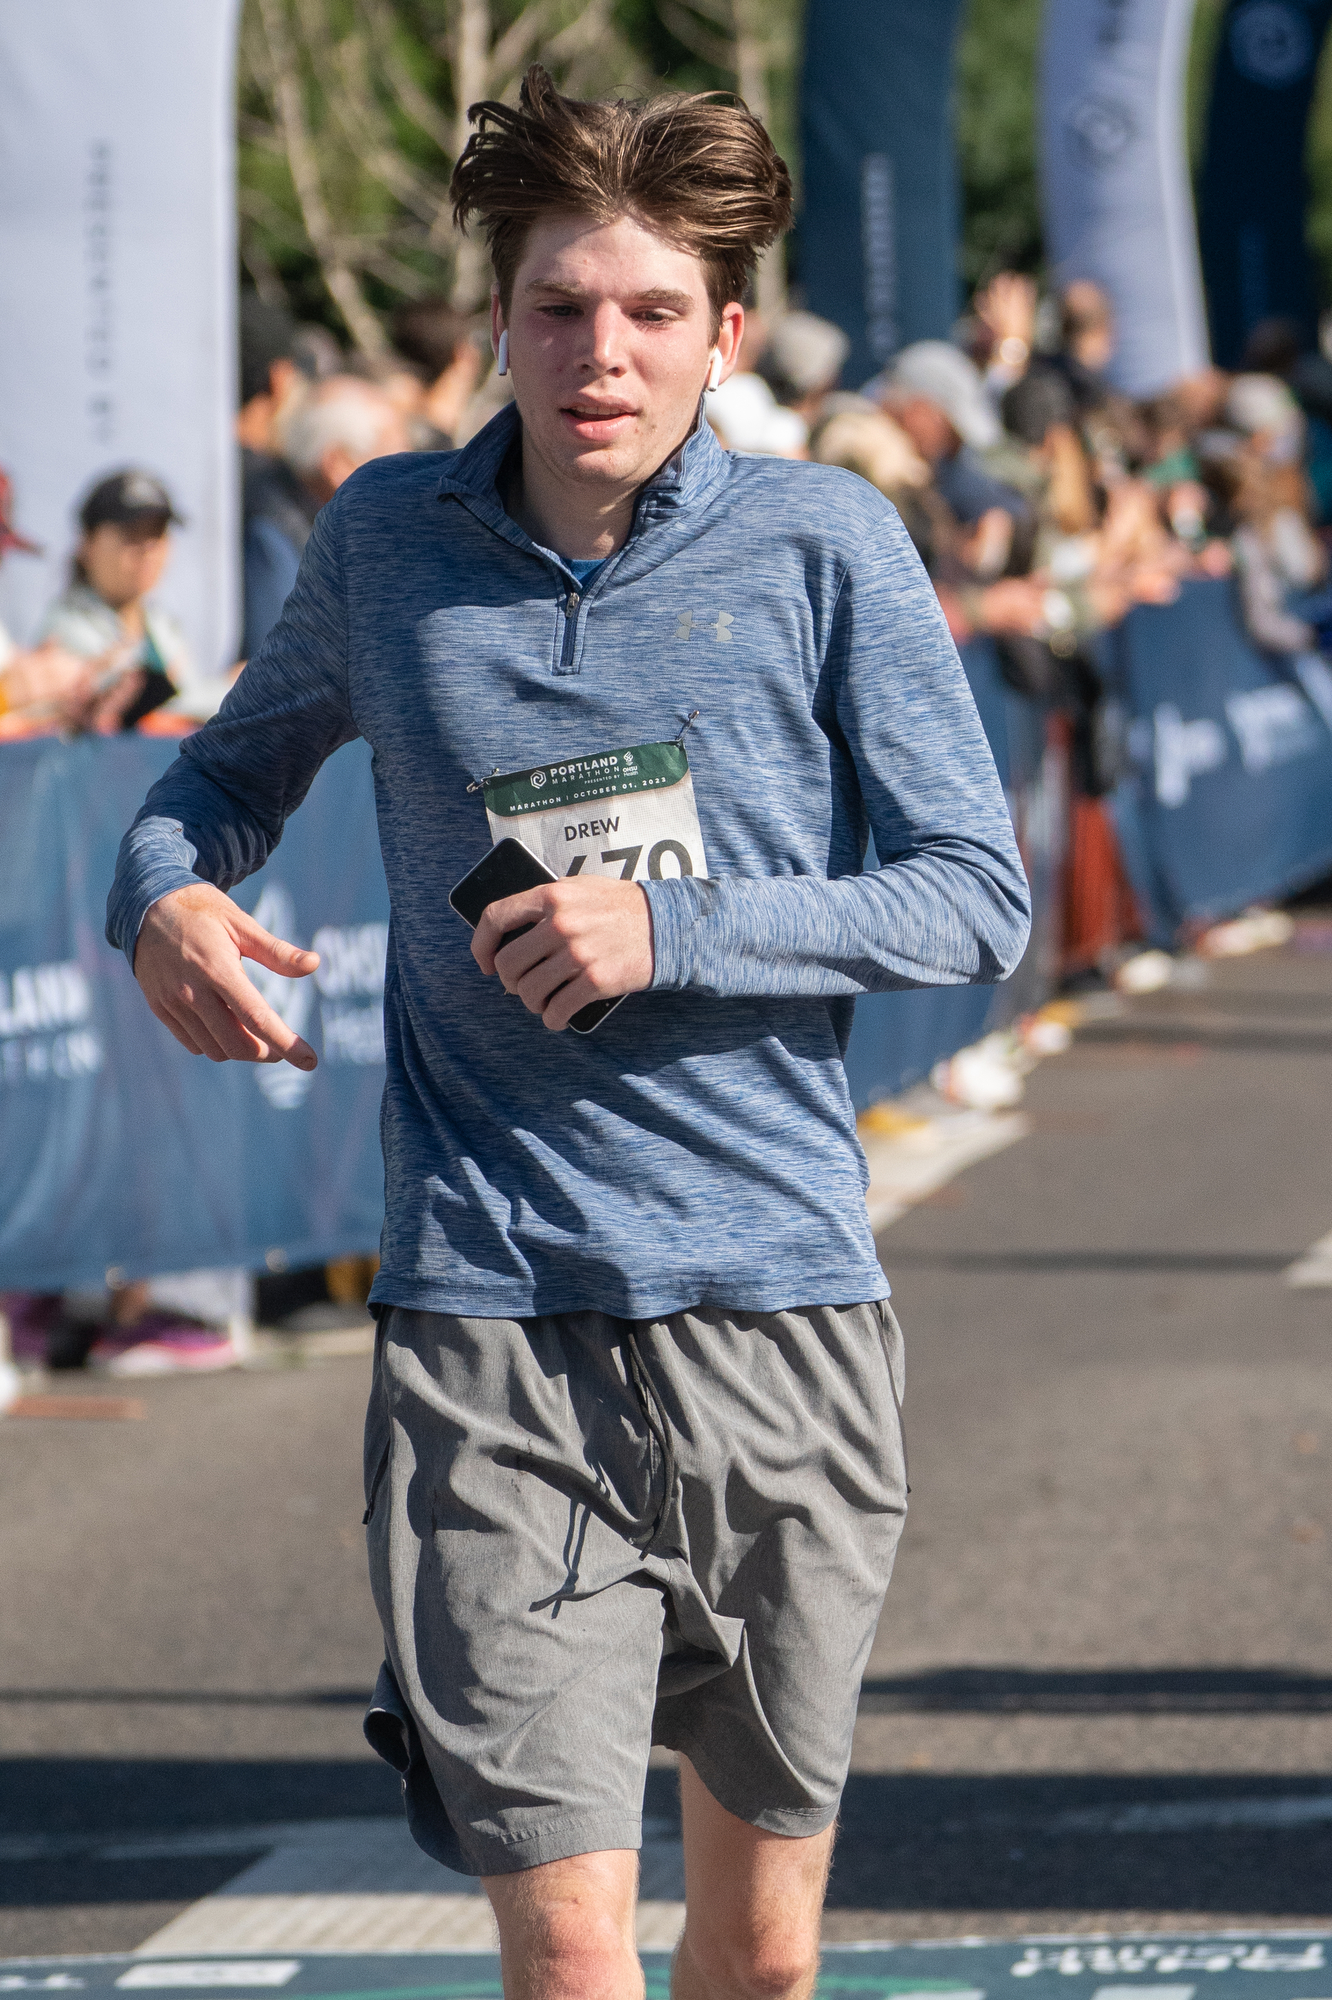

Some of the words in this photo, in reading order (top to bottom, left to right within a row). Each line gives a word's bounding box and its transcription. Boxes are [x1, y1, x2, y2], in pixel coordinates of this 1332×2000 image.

[549, 756, 618, 778] PORTLAND
[552, 765, 620, 785] MARATHON
[509, 796, 562, 812] MARATHON
[573, 785, 617, 799] OCTOBER
[642, 776, 666, 787] 2023
[564, 816, 620, 841] DREW
